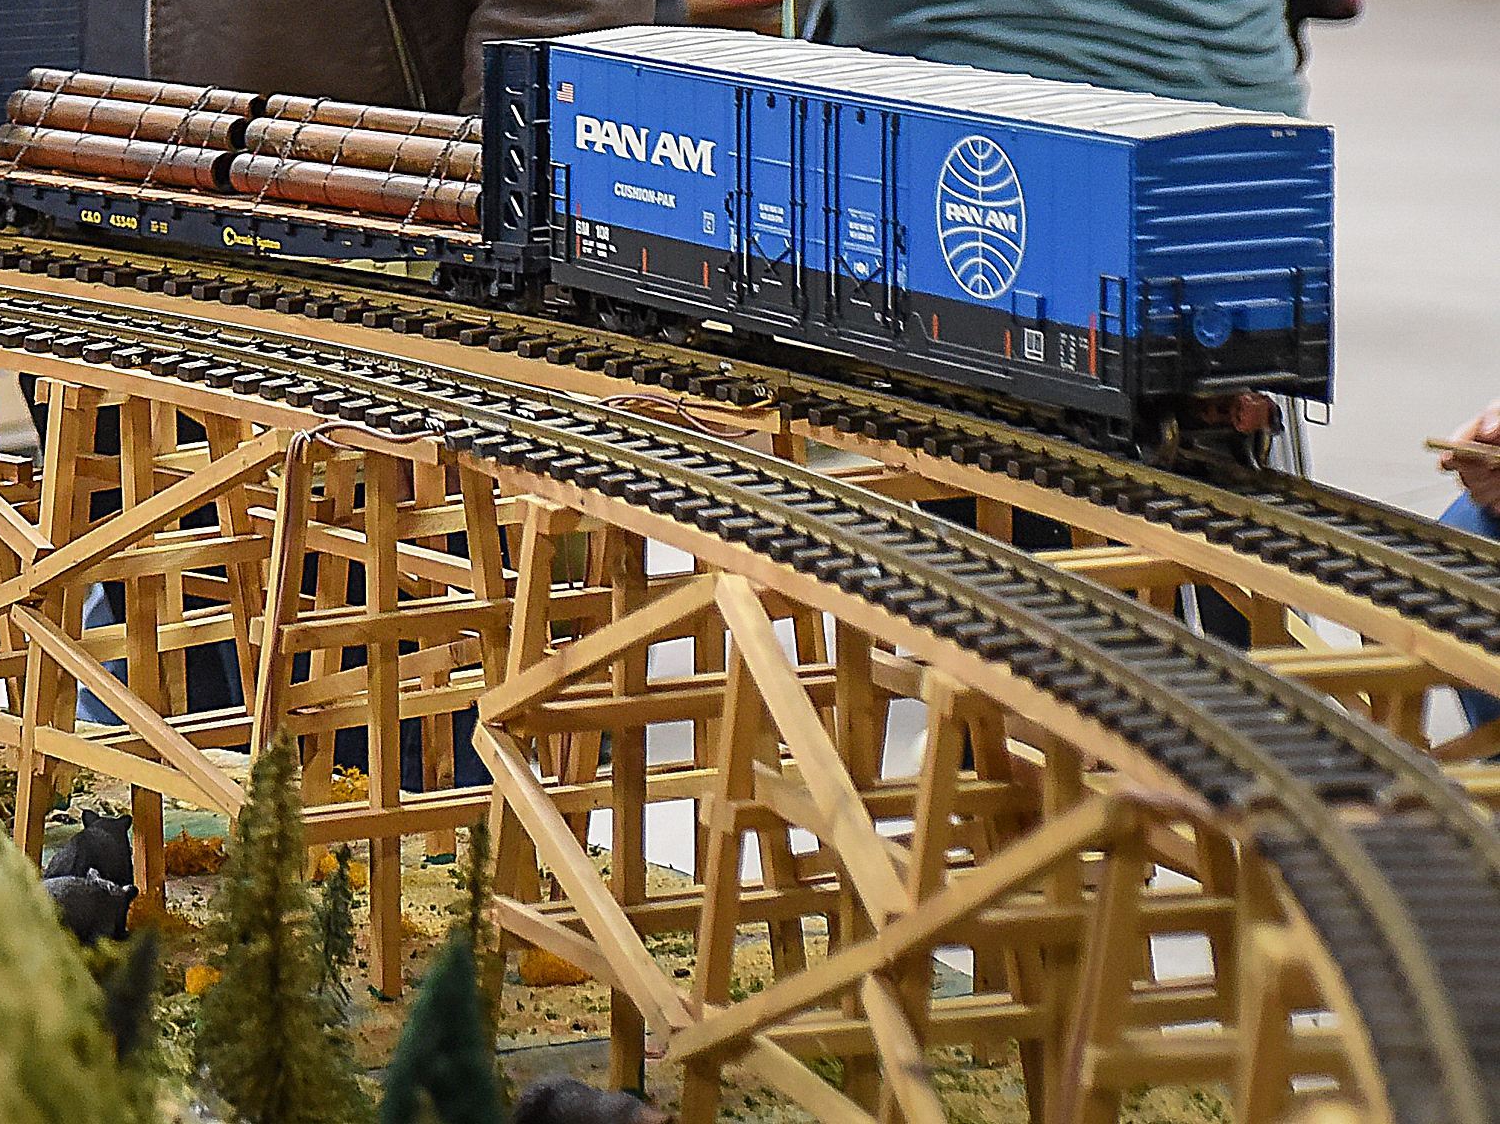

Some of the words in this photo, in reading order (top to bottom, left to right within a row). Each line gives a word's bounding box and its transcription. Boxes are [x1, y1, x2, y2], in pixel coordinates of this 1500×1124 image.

[575, 114, 650, 163] PAN
[650, 131, 717, 177] AM
[613, 181, 677, 209] CUSHION-PAK
[80, 209, 102, 224] C&O
[945, 202, 983, 226] PAN
[984, 209, 1018, 234] AM
